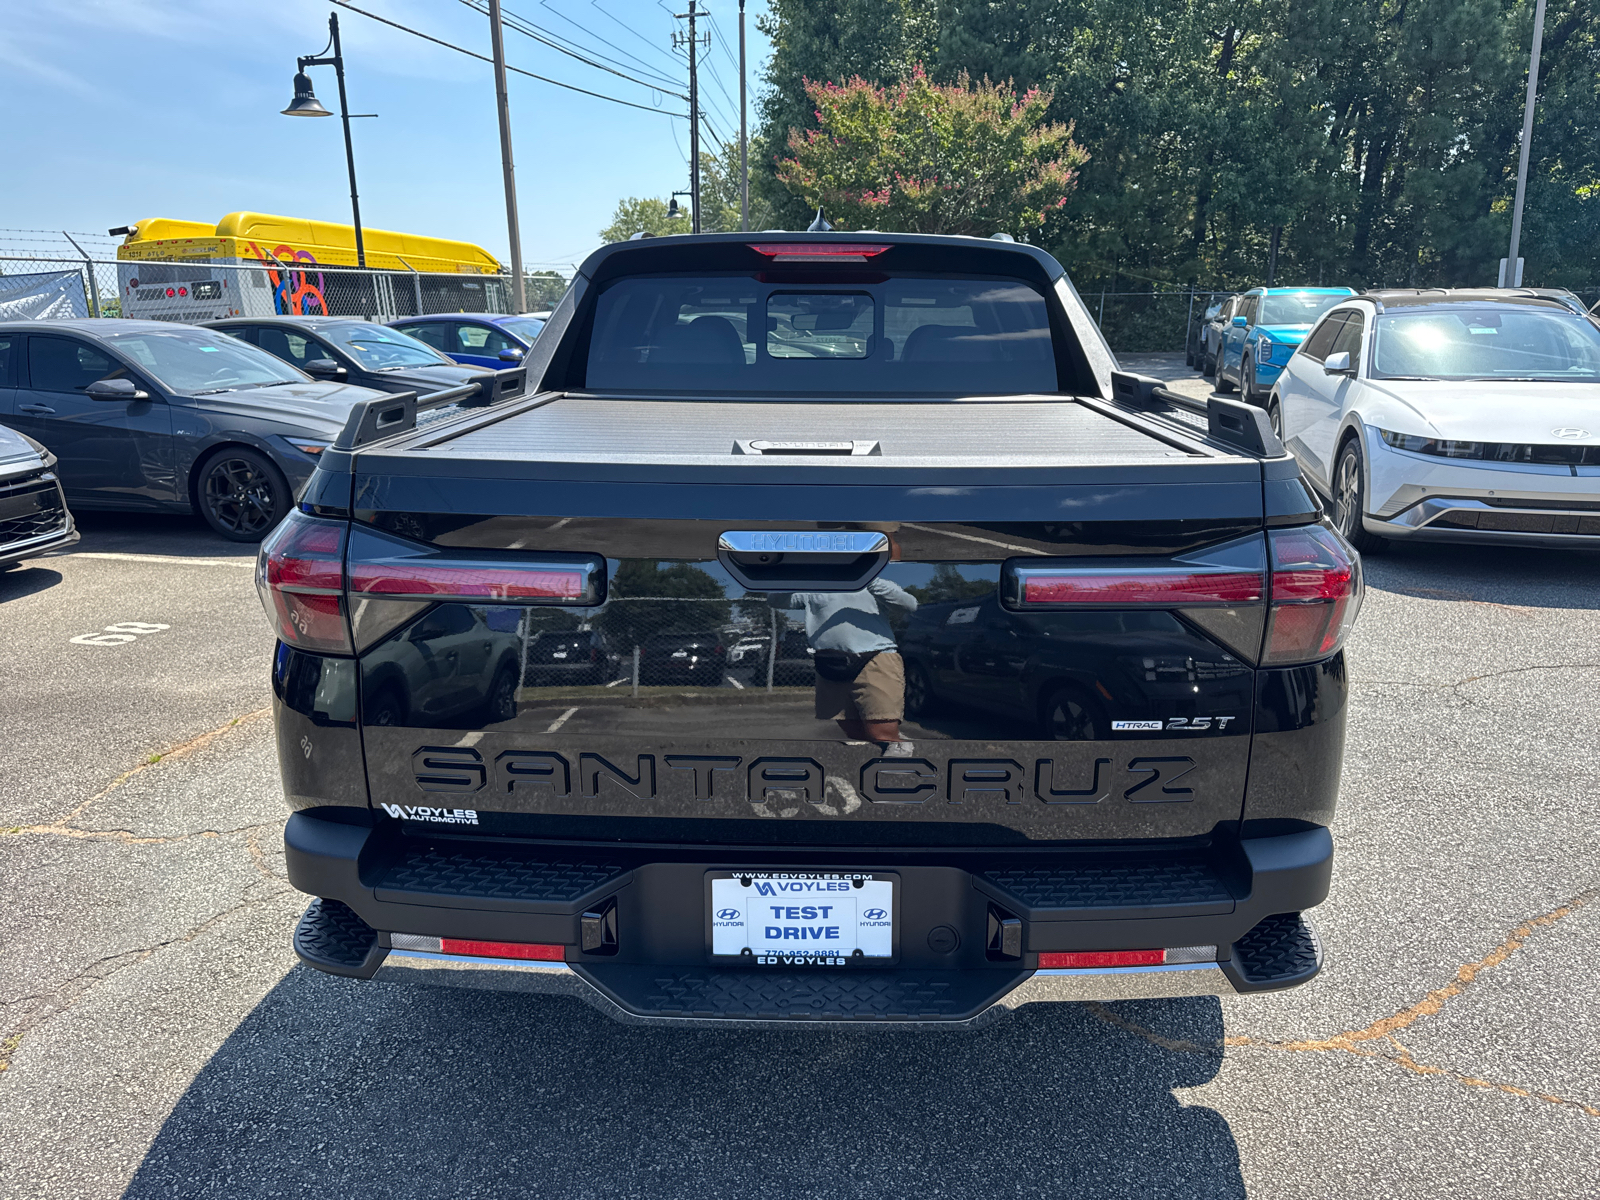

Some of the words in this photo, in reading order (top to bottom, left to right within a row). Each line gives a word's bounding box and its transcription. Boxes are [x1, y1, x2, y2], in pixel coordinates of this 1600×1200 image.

[750, 533, 856, 551] HYUNDAI
[69, 621, 171, 646] 68
[1114, 722, 1161, 730] HTRAC
[411, 744, 826, 804] SANTA
[858, 754, 1198, 805] CRUZ
[404, 805, 478, 819] VOYLES
[409, 814, 479, 825] AUTOMOTIVE
[732, 872, 873, 880] WWW.EDVOYLES.COM
[777, 881, 850, 892] VOYLES
[769, 905, 833, 920] TEST
[764, 926, 840, 940] DRIVE
[757, 956, 781, 964] ED
[783, 957, 846, 966] VOYLES
